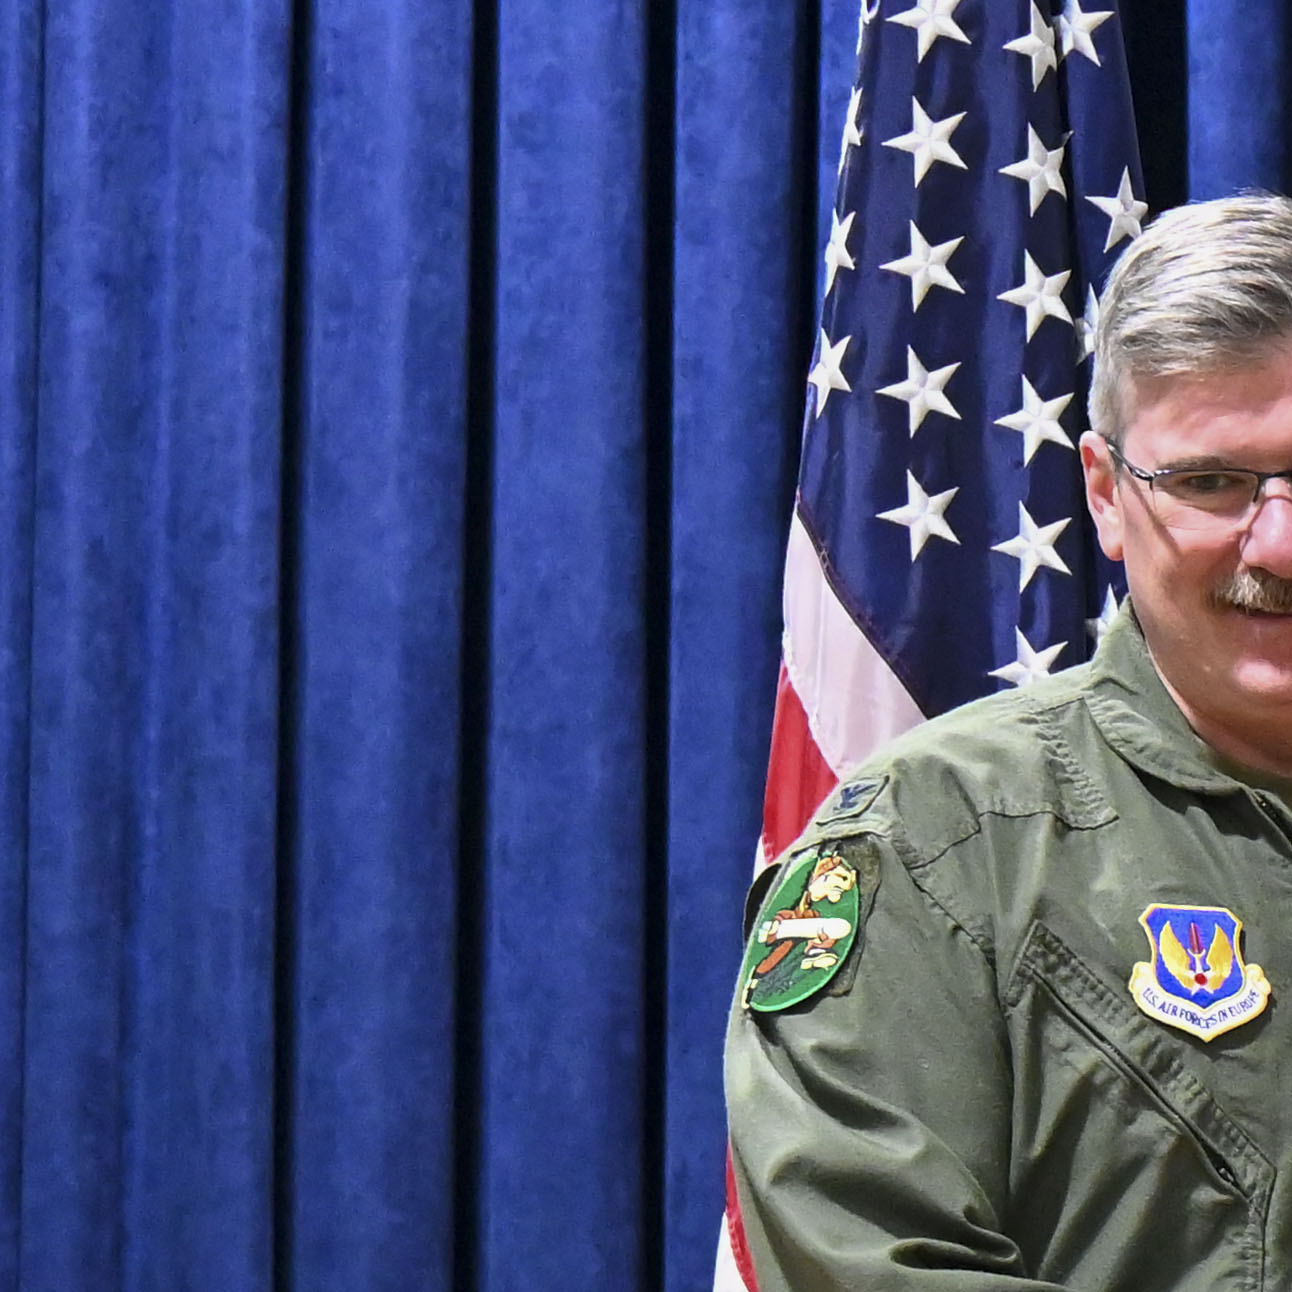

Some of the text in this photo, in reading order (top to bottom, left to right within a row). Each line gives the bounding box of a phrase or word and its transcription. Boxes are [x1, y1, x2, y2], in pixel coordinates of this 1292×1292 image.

[1158, 1002, 1178, 1017] AIR
[1180, 1008, 1218, 1029] FORCES
[1217, 1011, 1228, 1022] IN
[1229, 989, 1260, 1017] EUROPE
